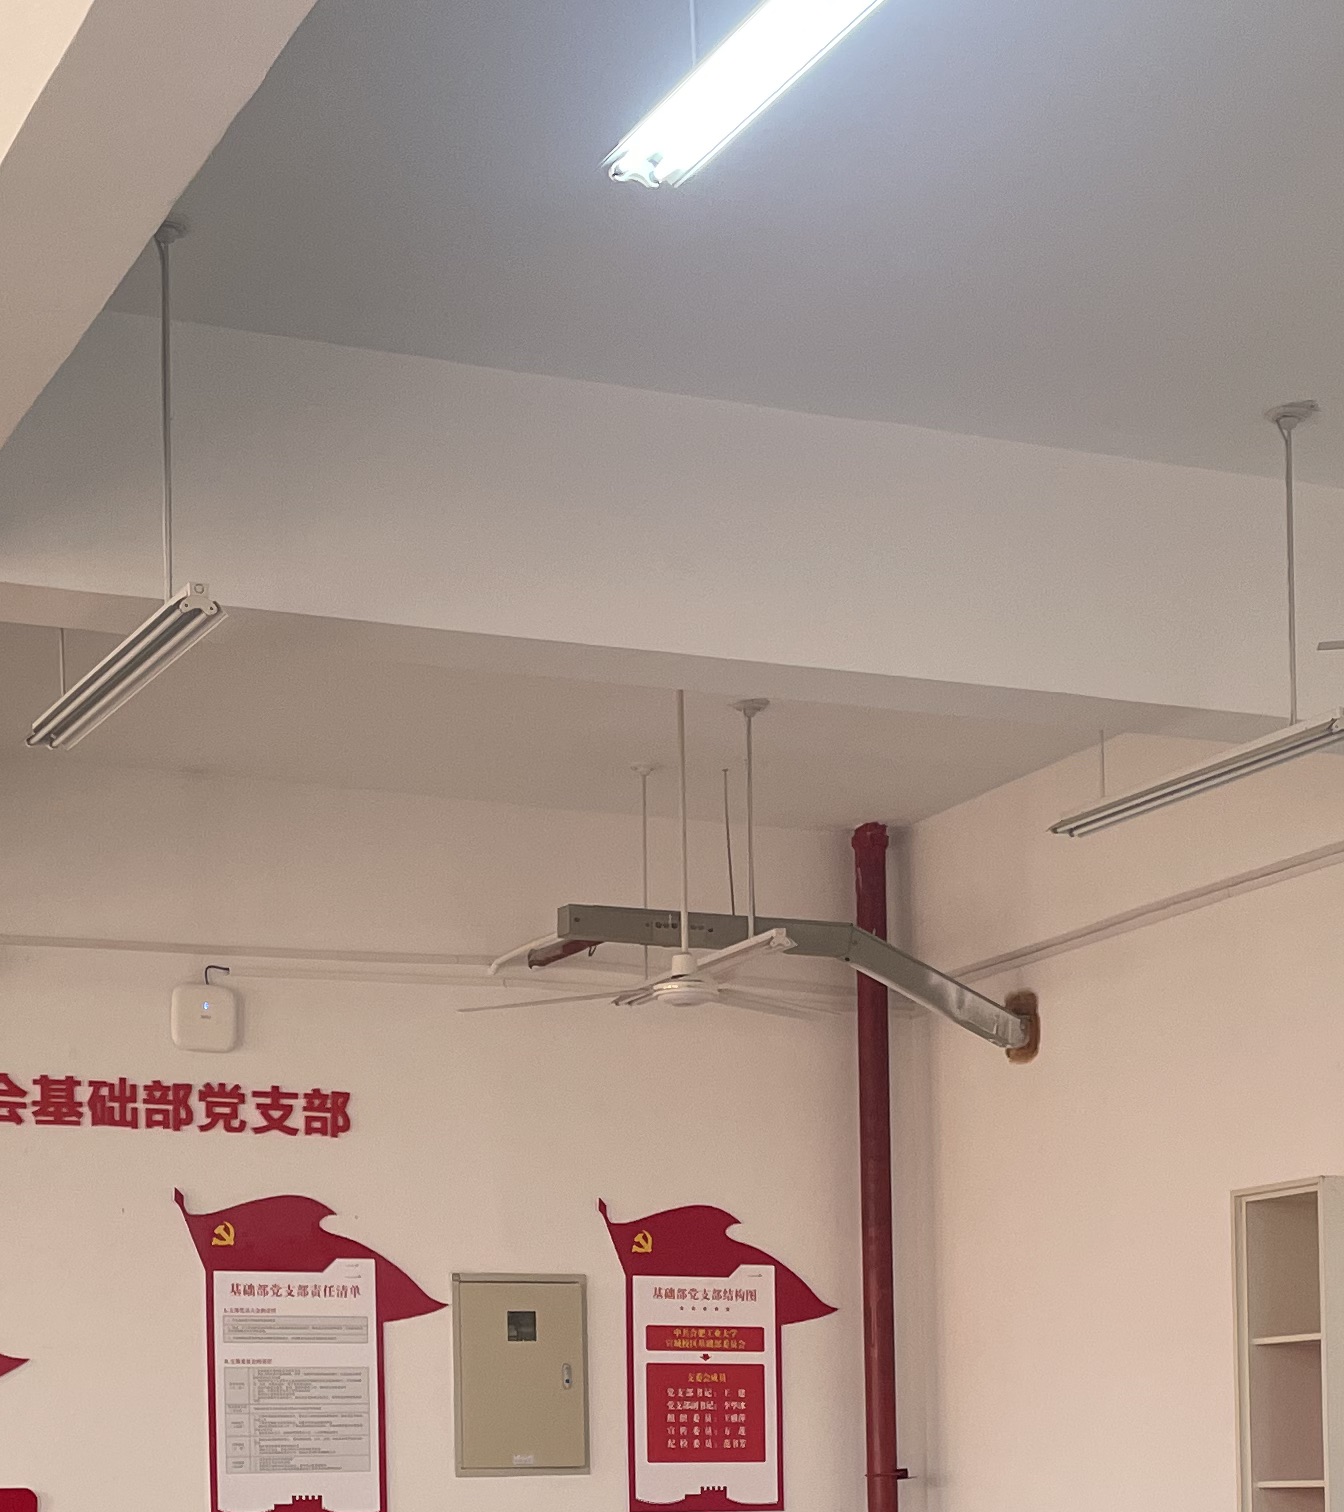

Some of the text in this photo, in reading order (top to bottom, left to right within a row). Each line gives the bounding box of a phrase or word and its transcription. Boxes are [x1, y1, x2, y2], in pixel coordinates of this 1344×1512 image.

[229, 1282, 362, 1299] 基础部党支部责任清单
[652, 1286, 757, 1303] 基础部党支部结构图
